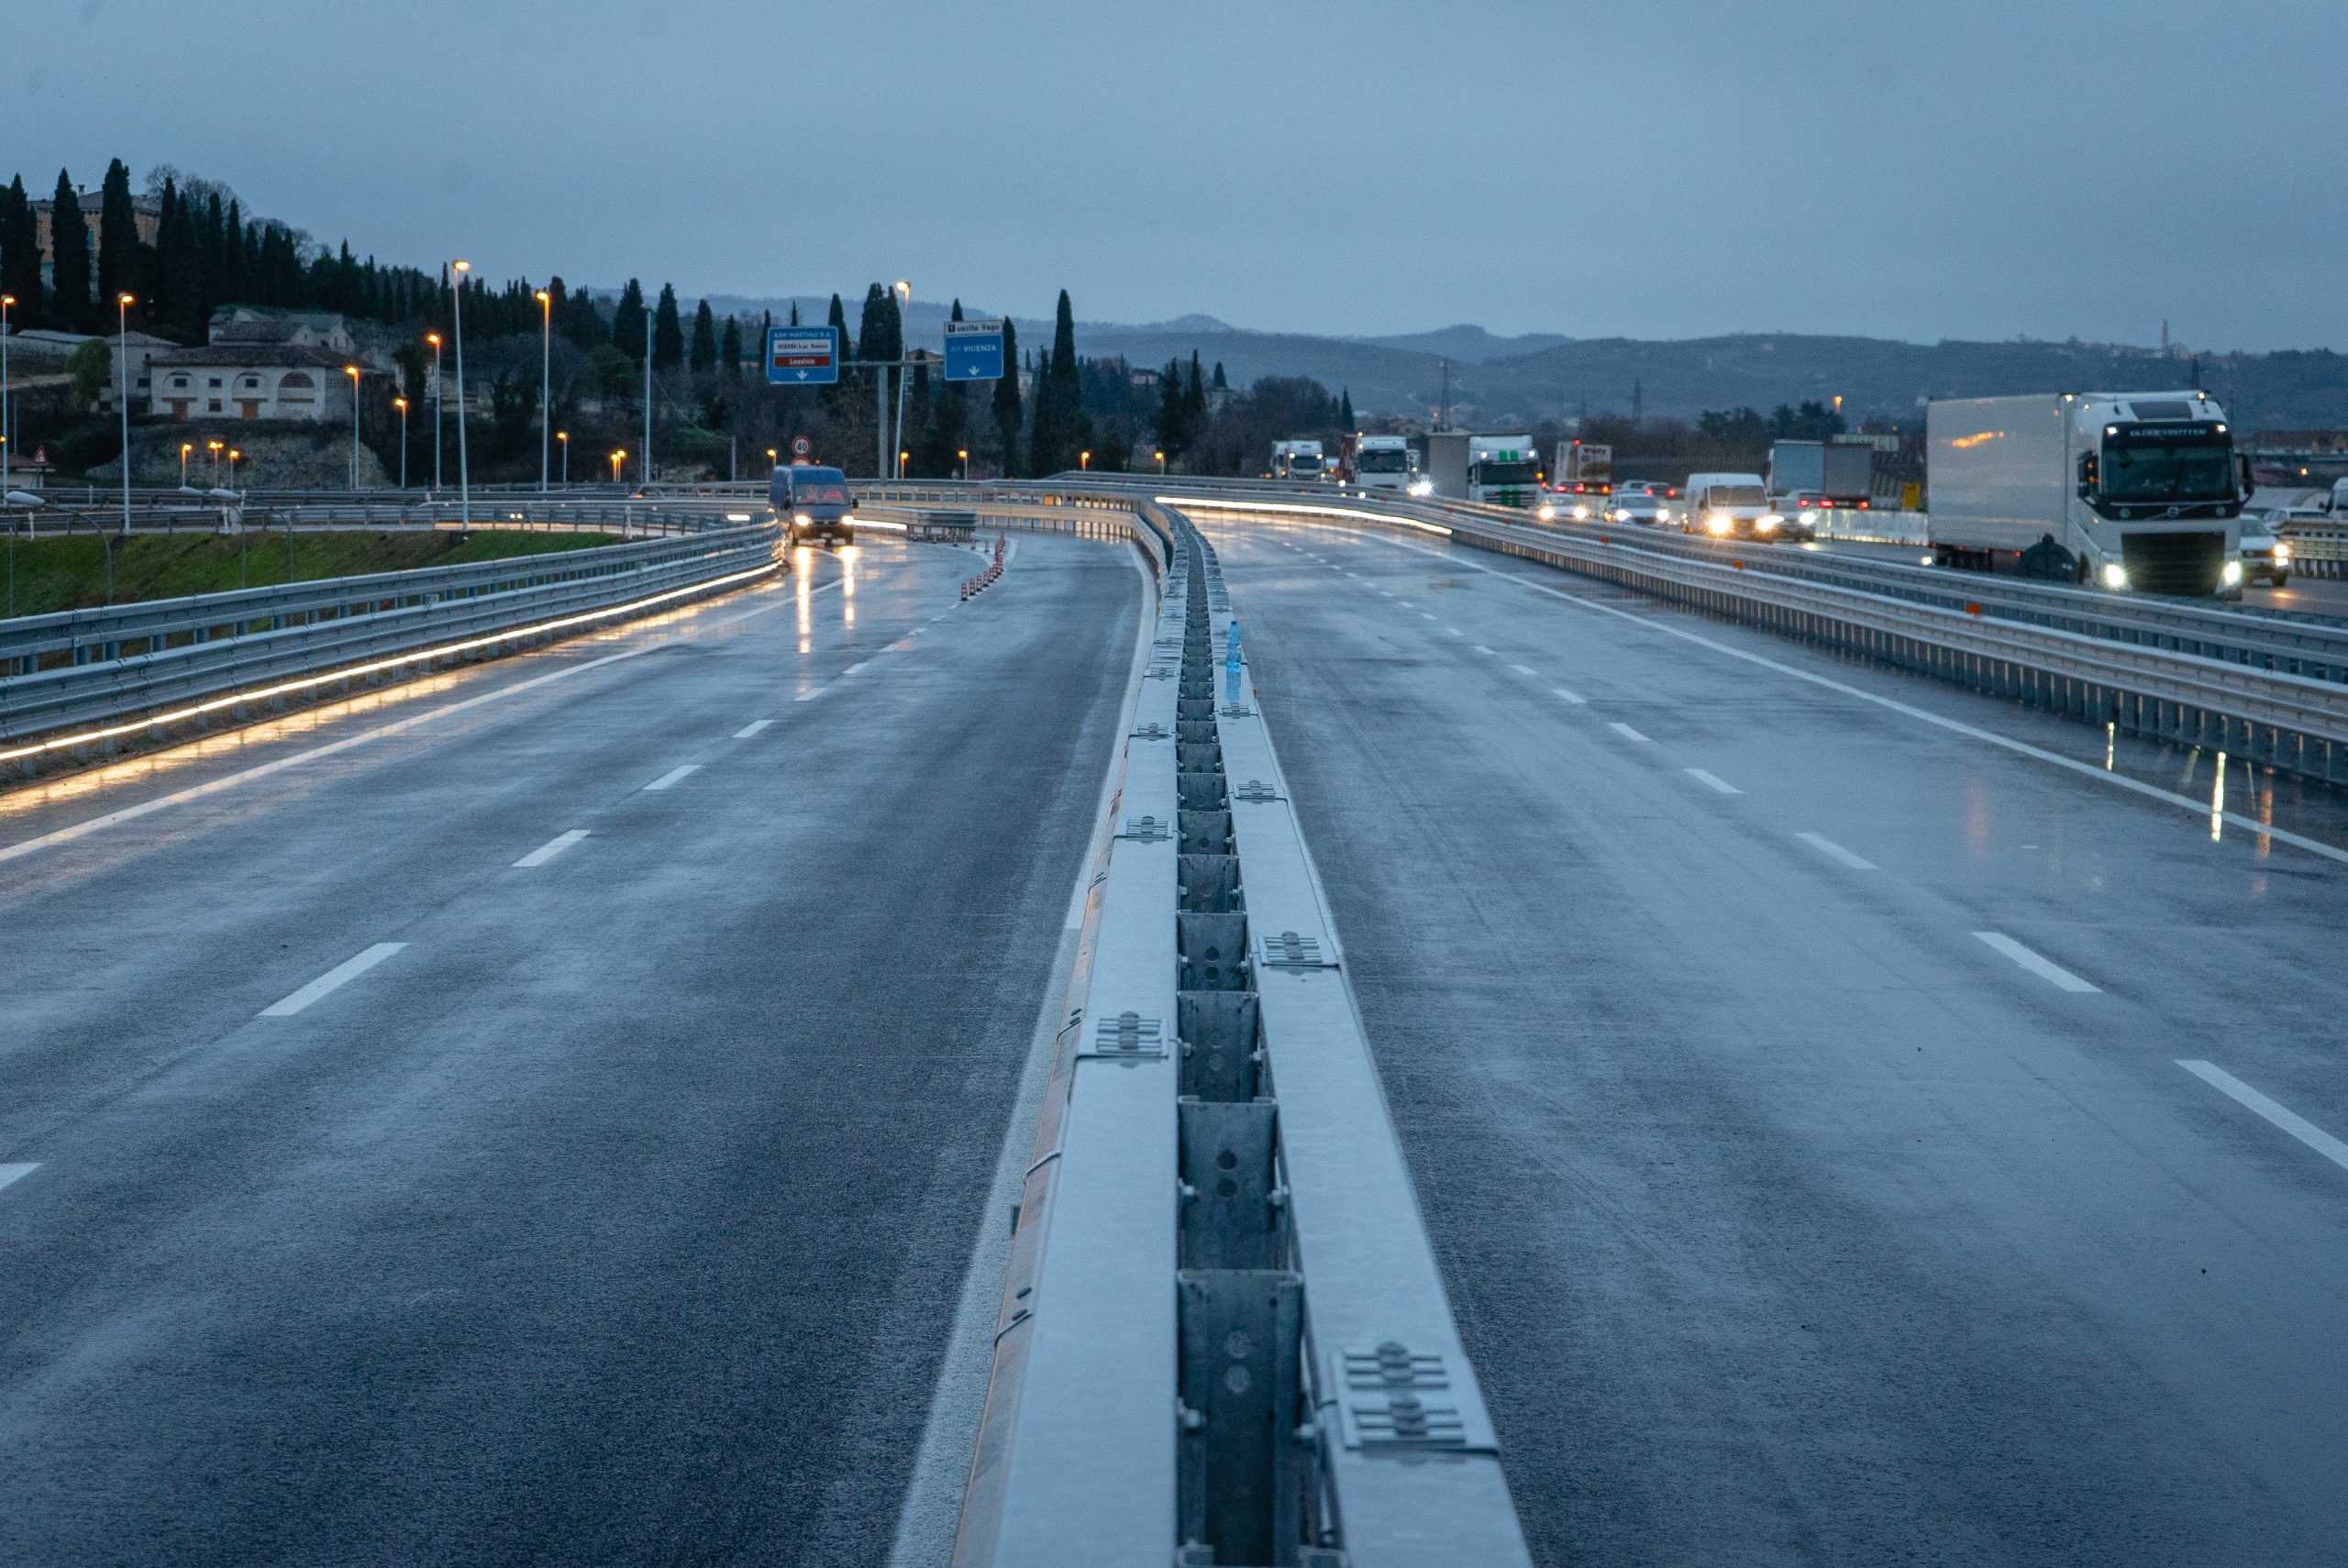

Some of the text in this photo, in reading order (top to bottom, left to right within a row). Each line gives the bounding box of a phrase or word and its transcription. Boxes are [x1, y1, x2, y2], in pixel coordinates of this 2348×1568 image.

[981, 323, 1000, 332] Vago
[962, 344, 997, 352] VICENZA
[797, 442, 808, 451] 40
